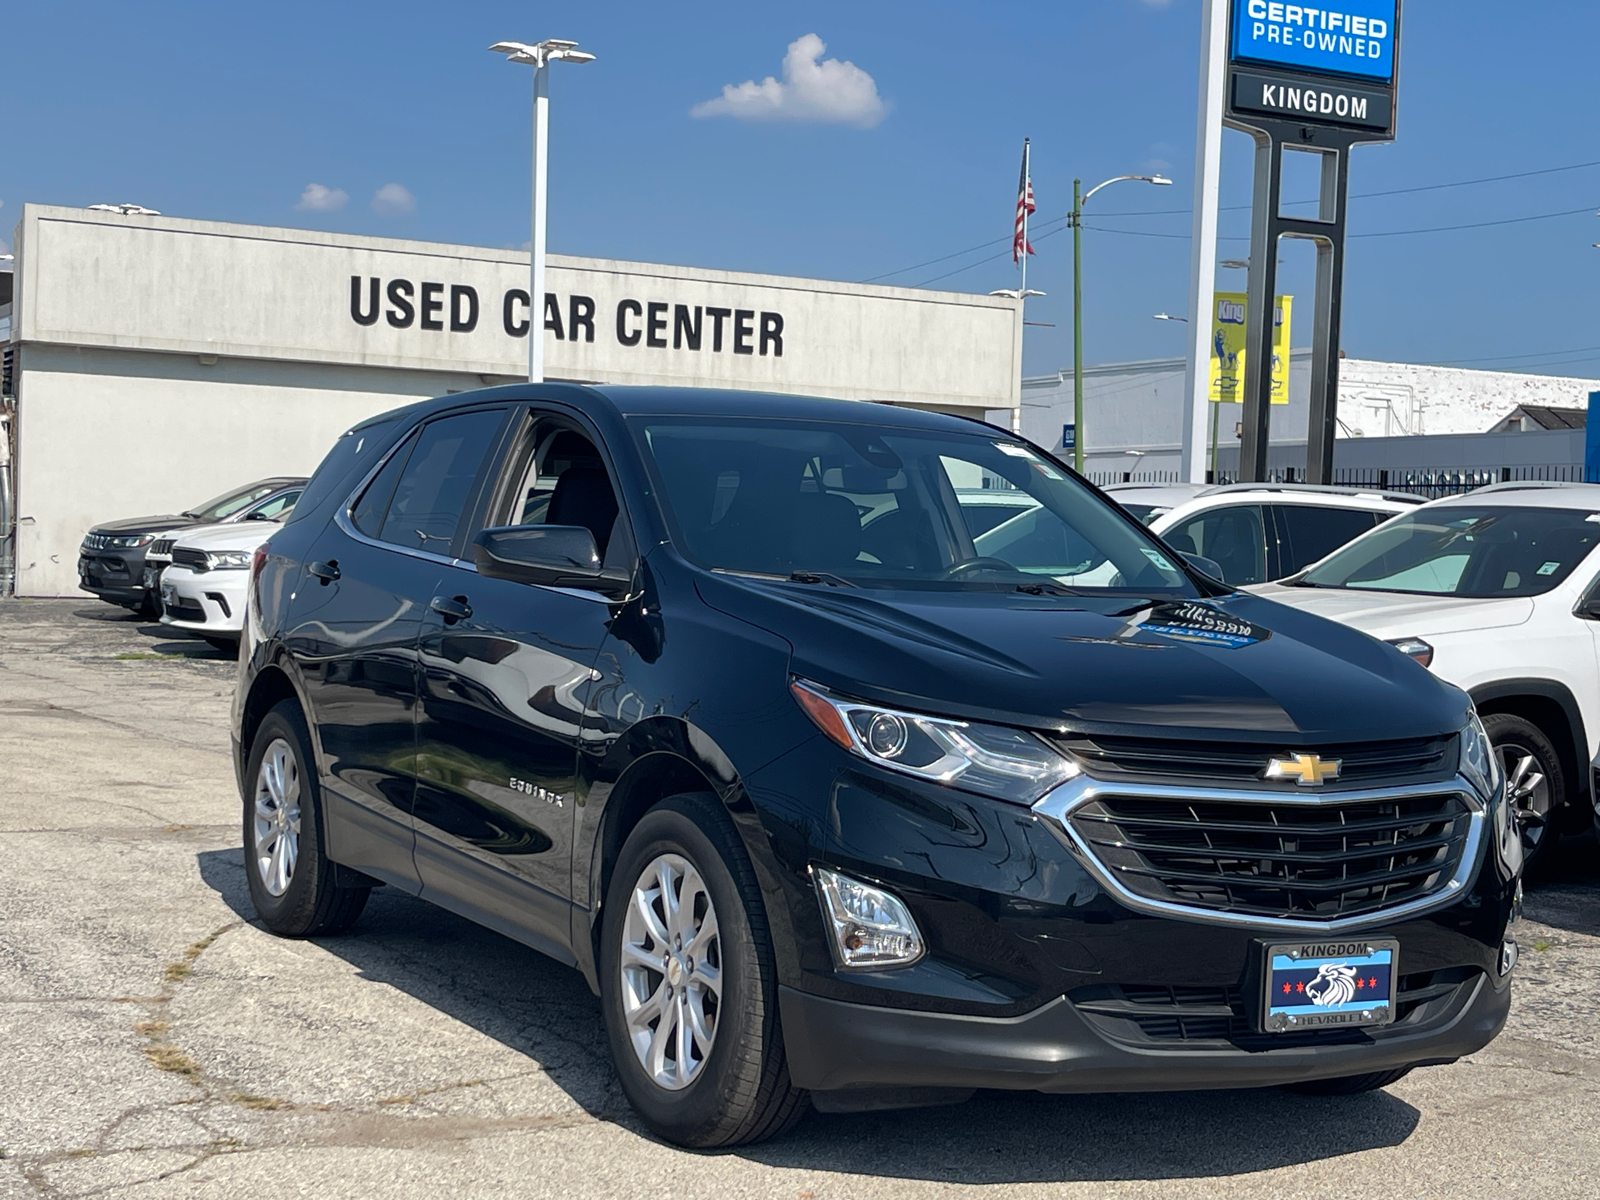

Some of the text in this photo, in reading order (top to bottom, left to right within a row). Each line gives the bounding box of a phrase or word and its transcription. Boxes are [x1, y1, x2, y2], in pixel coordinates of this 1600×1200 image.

[1248, 0, 1387, 39] CERTIFIED
[1253, 22, 1381, 59] PRE-OWNED
[1262, 83, 1367, 119] KINGDOM
[350, 275, 785, 358] USED CAR CENTER
[509, 777, 564, 808] EQUINOX
[1300, 942, 1368, 957] KINGDOM
[1295, 1013, 1363, 1026] CHEVROLET
